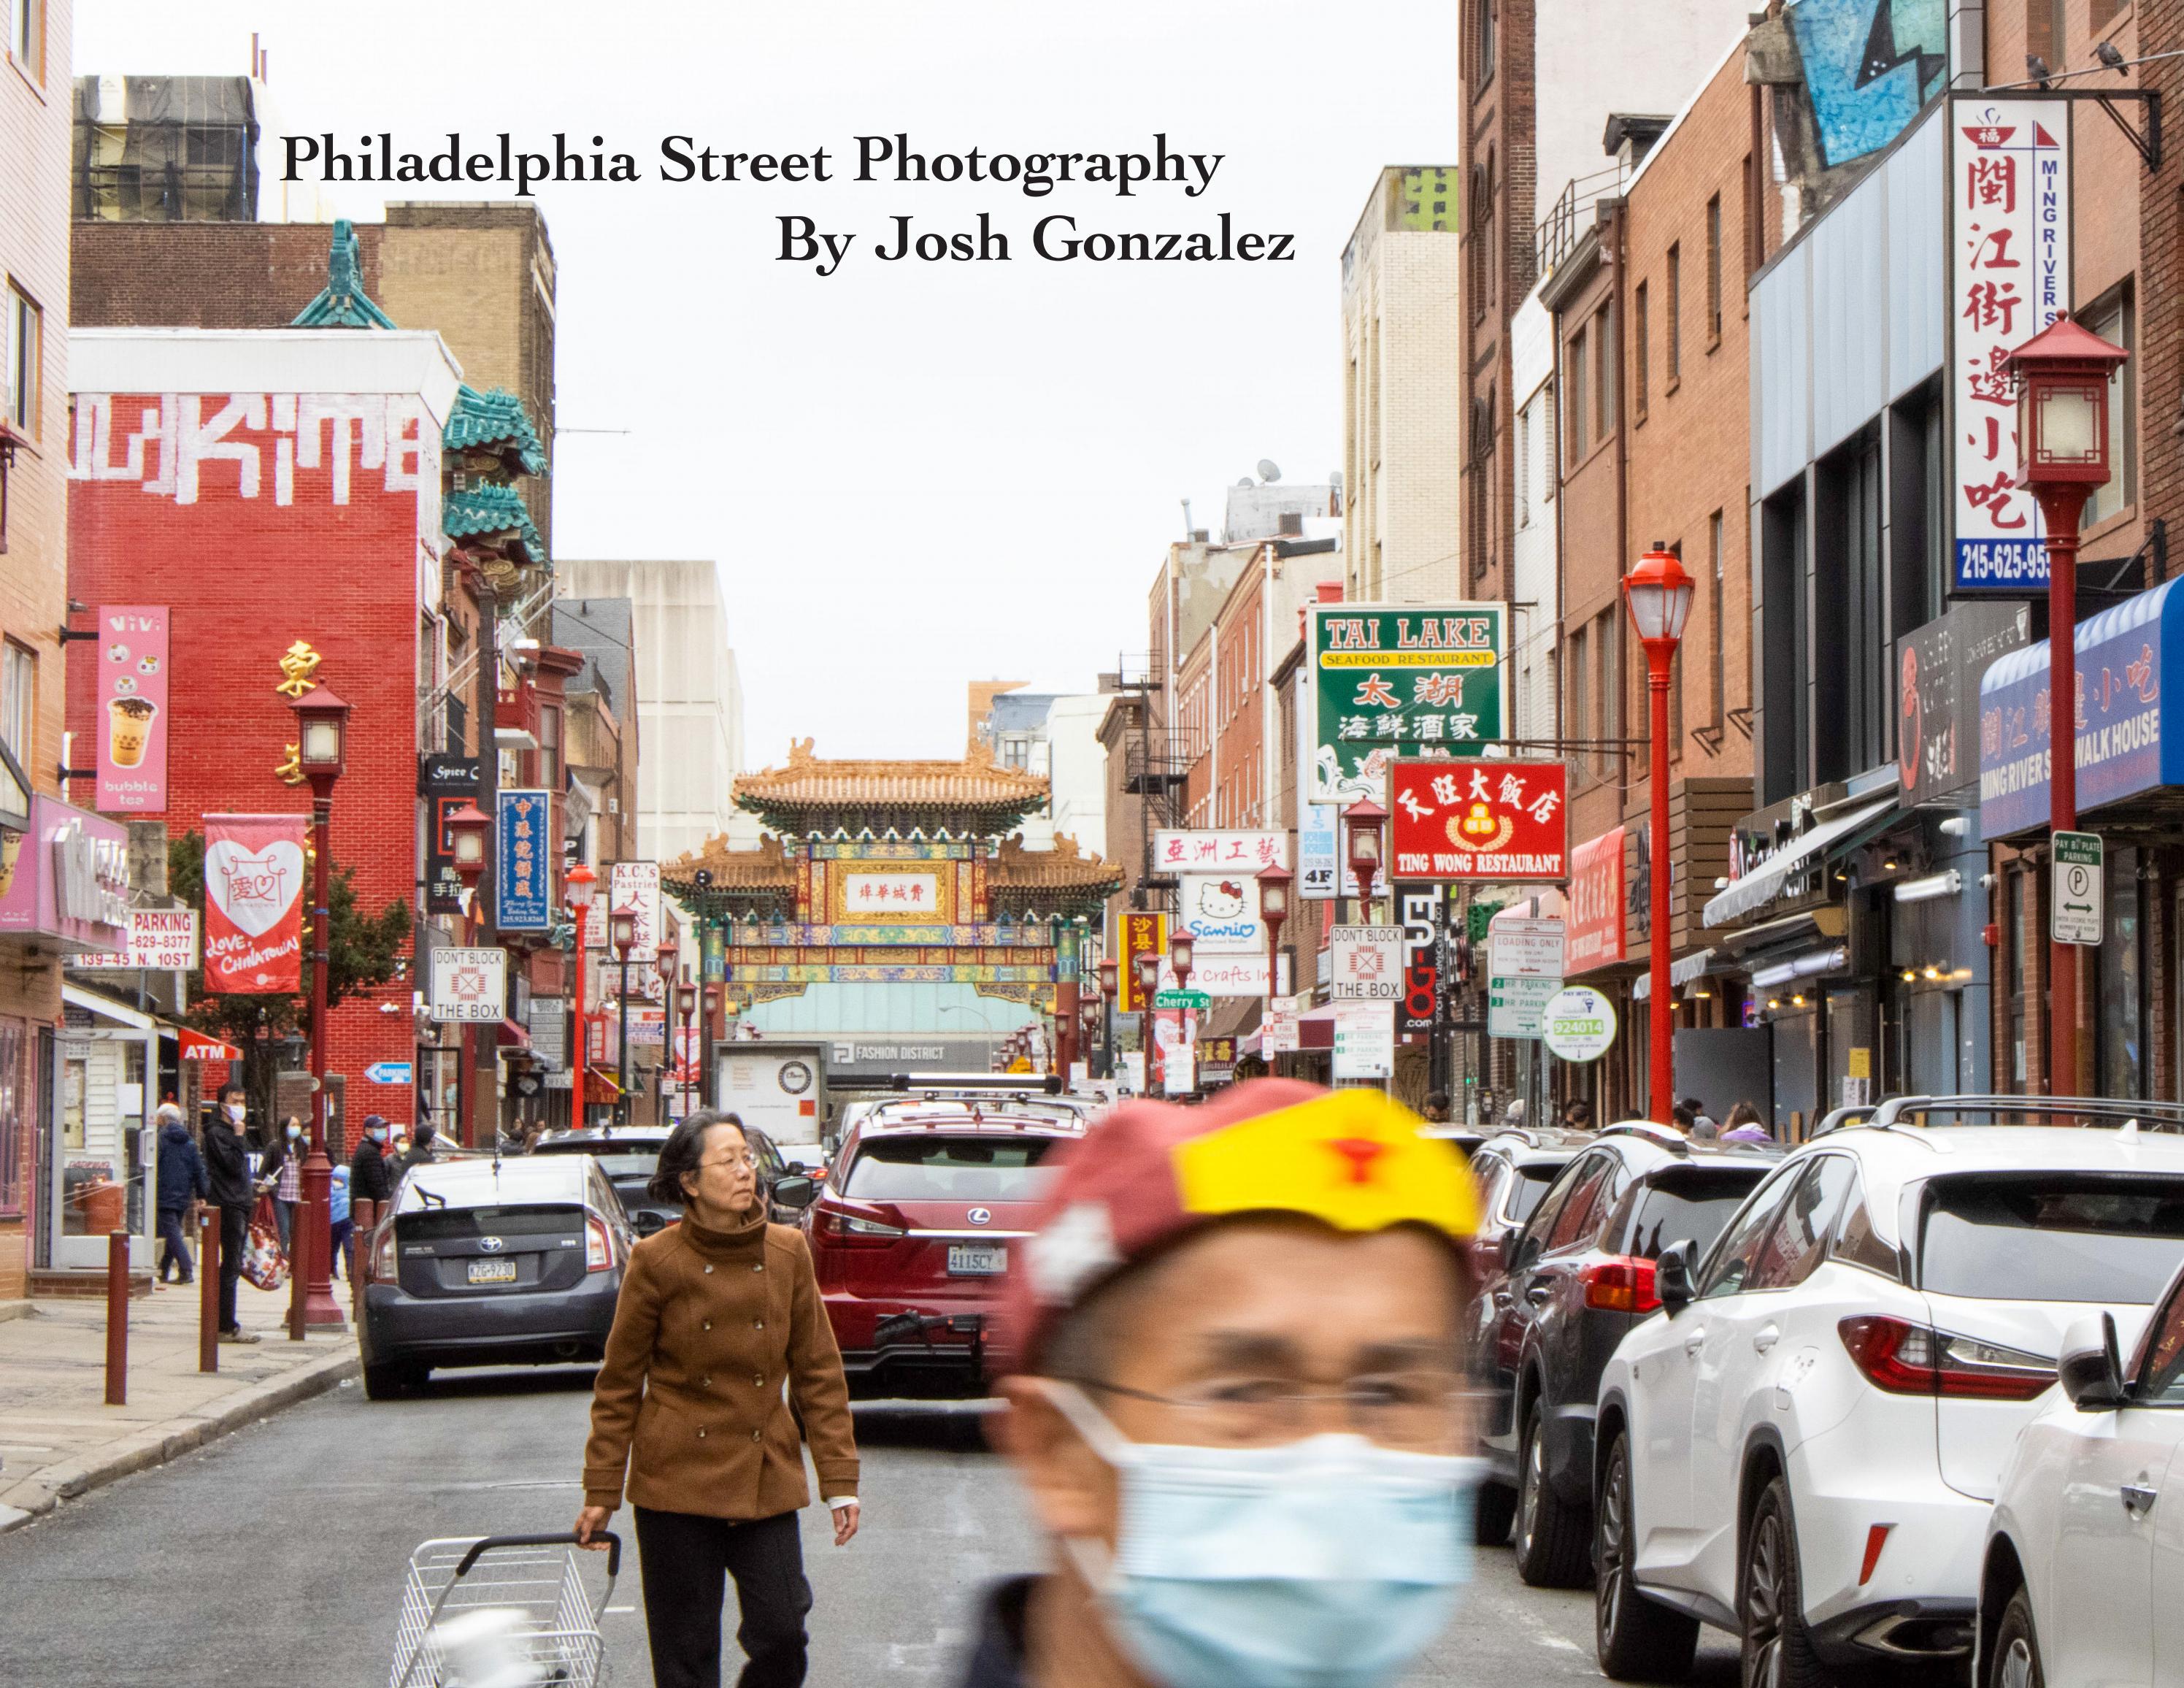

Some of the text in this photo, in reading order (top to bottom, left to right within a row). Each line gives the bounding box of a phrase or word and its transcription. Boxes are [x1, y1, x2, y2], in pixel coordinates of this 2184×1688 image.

[1979, 128, 2000, 144] 福
[2042, 160, 2058, 222] MING
[2043, 228, 2057, 306] RIVER
[1326, 618, 1490, 649] TAI LAKE
[1326, 653, 1490, 665] SEAFOOD RESTAURANT
[1353, 673, 1464, 708] 太湖
[1339, 714, 1479, 740] 海鮮酒家
[1980, 766, 2007, 802] MING
[2008, 753, 2042, 793] RIVER
[2112, 707, 2159, 756] HOUSE
[432, 765, 466, 778] Spice
[105, 780, 158, 792] bubble
[119, 794, 145, 805] tea
[1397, 768, 1560, 824] 天旺大飯店
[1164, 837, 1280, 864] 亞洲工藝
[2055, 840, 2068, 848] PAY
[2082, 842, 2100, 851] PLATE
[1398, 854, 1561, 872] TING WONG RESTAURANT
[2064, 851, 2093, 863] PARKING
[1305, 870, 1334, 883] 4F
[615, 880, 658, 889] Pastries
[135, 913, 191, 931] PARKING
[1190, 920, 1256, 937] Sanrio
[1366, 929, 1399, 942] BLOCK
[1498, 937, 1560, 948] LOADING ONLY
[80, 953, 191, 966] 139-45 N. 10ST
[221, 936, 299, 974] CHINATOWN
[437, 951, 501, 964] DON'T BLOCK
[1202, 966, 1251, 986] Crafts
[1337, 983, 1399, 997] THE BOX
[1520, 981, 1552, 990] PARKING
[1156, 997, 1210, 1010] Cherry St
[1520, 1000, 1547, 1008] PARKIN
[438, 1005, 499, 1018] THE BOX
[1405, 1019, 1432, 1028] .com
[1556, 1021, 1603, 1033] 924014
[185, 1046, 226, 1059] ATM
[856, 1046, 945, 1060] FASHION DISTRICT
[378, 1068, 410, 1077] PARKING
